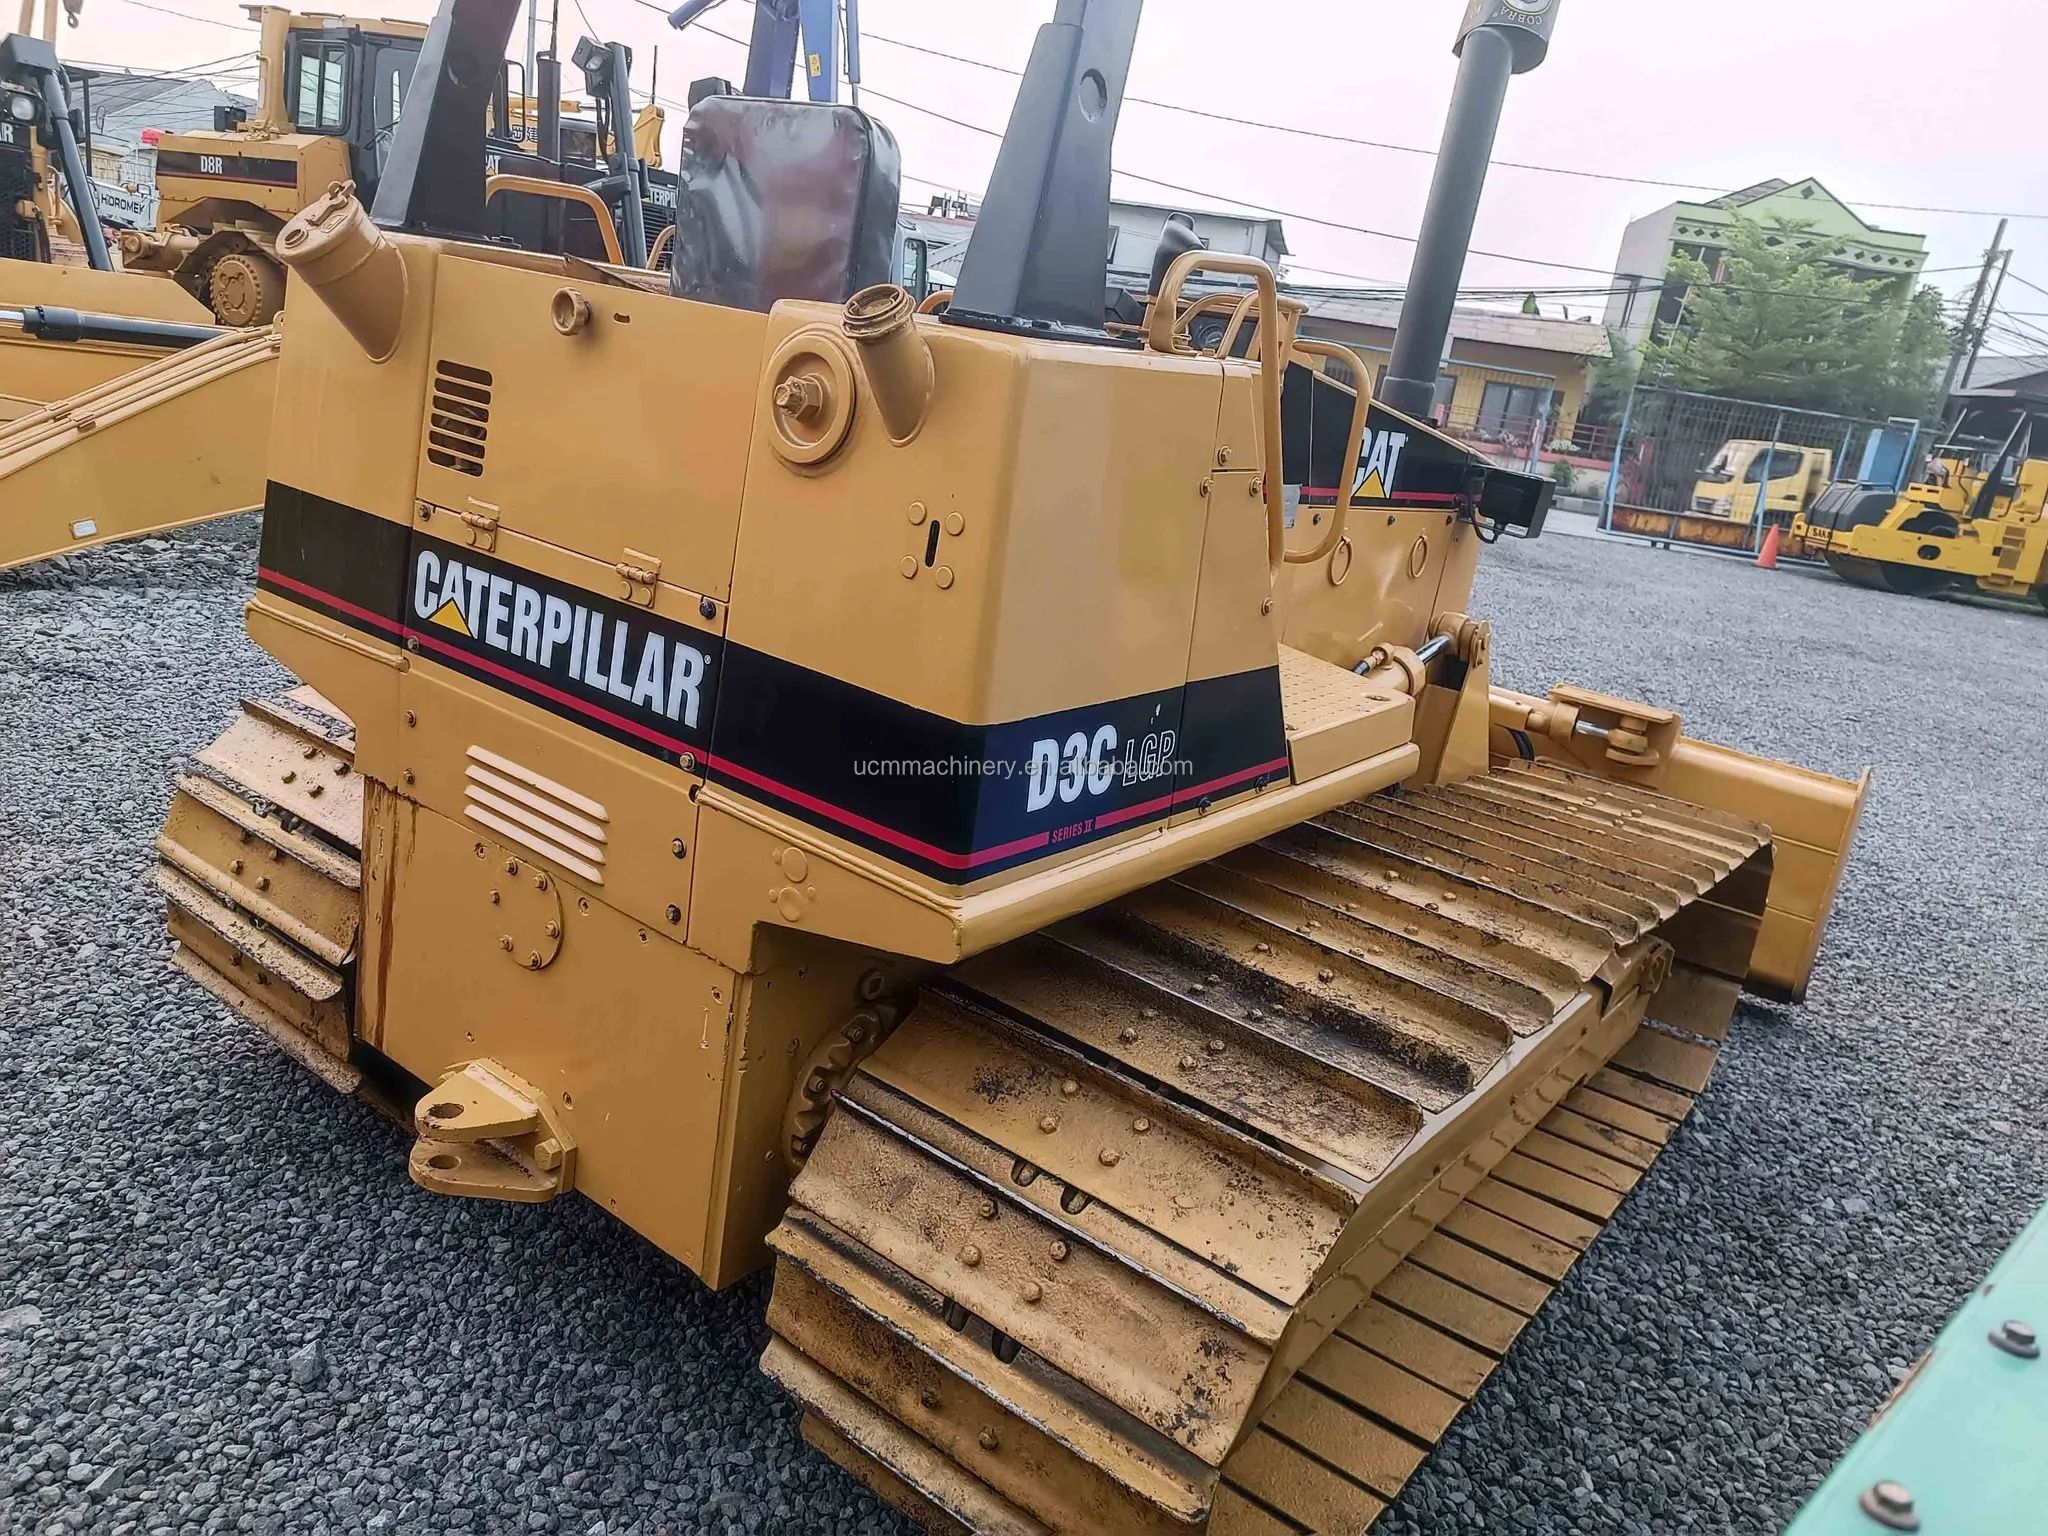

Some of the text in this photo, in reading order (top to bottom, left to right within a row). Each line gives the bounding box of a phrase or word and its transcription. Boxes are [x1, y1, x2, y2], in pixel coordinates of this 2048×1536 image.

[1500, 5, 1542, 25] COBRA
[200, 155, 223, 175] D8R
[414, 549, 704, 731] CATERPILLAR
[1026, 724, 1176, 813] D3C LGP
[1051, 825, 1083, 844] SERIES
